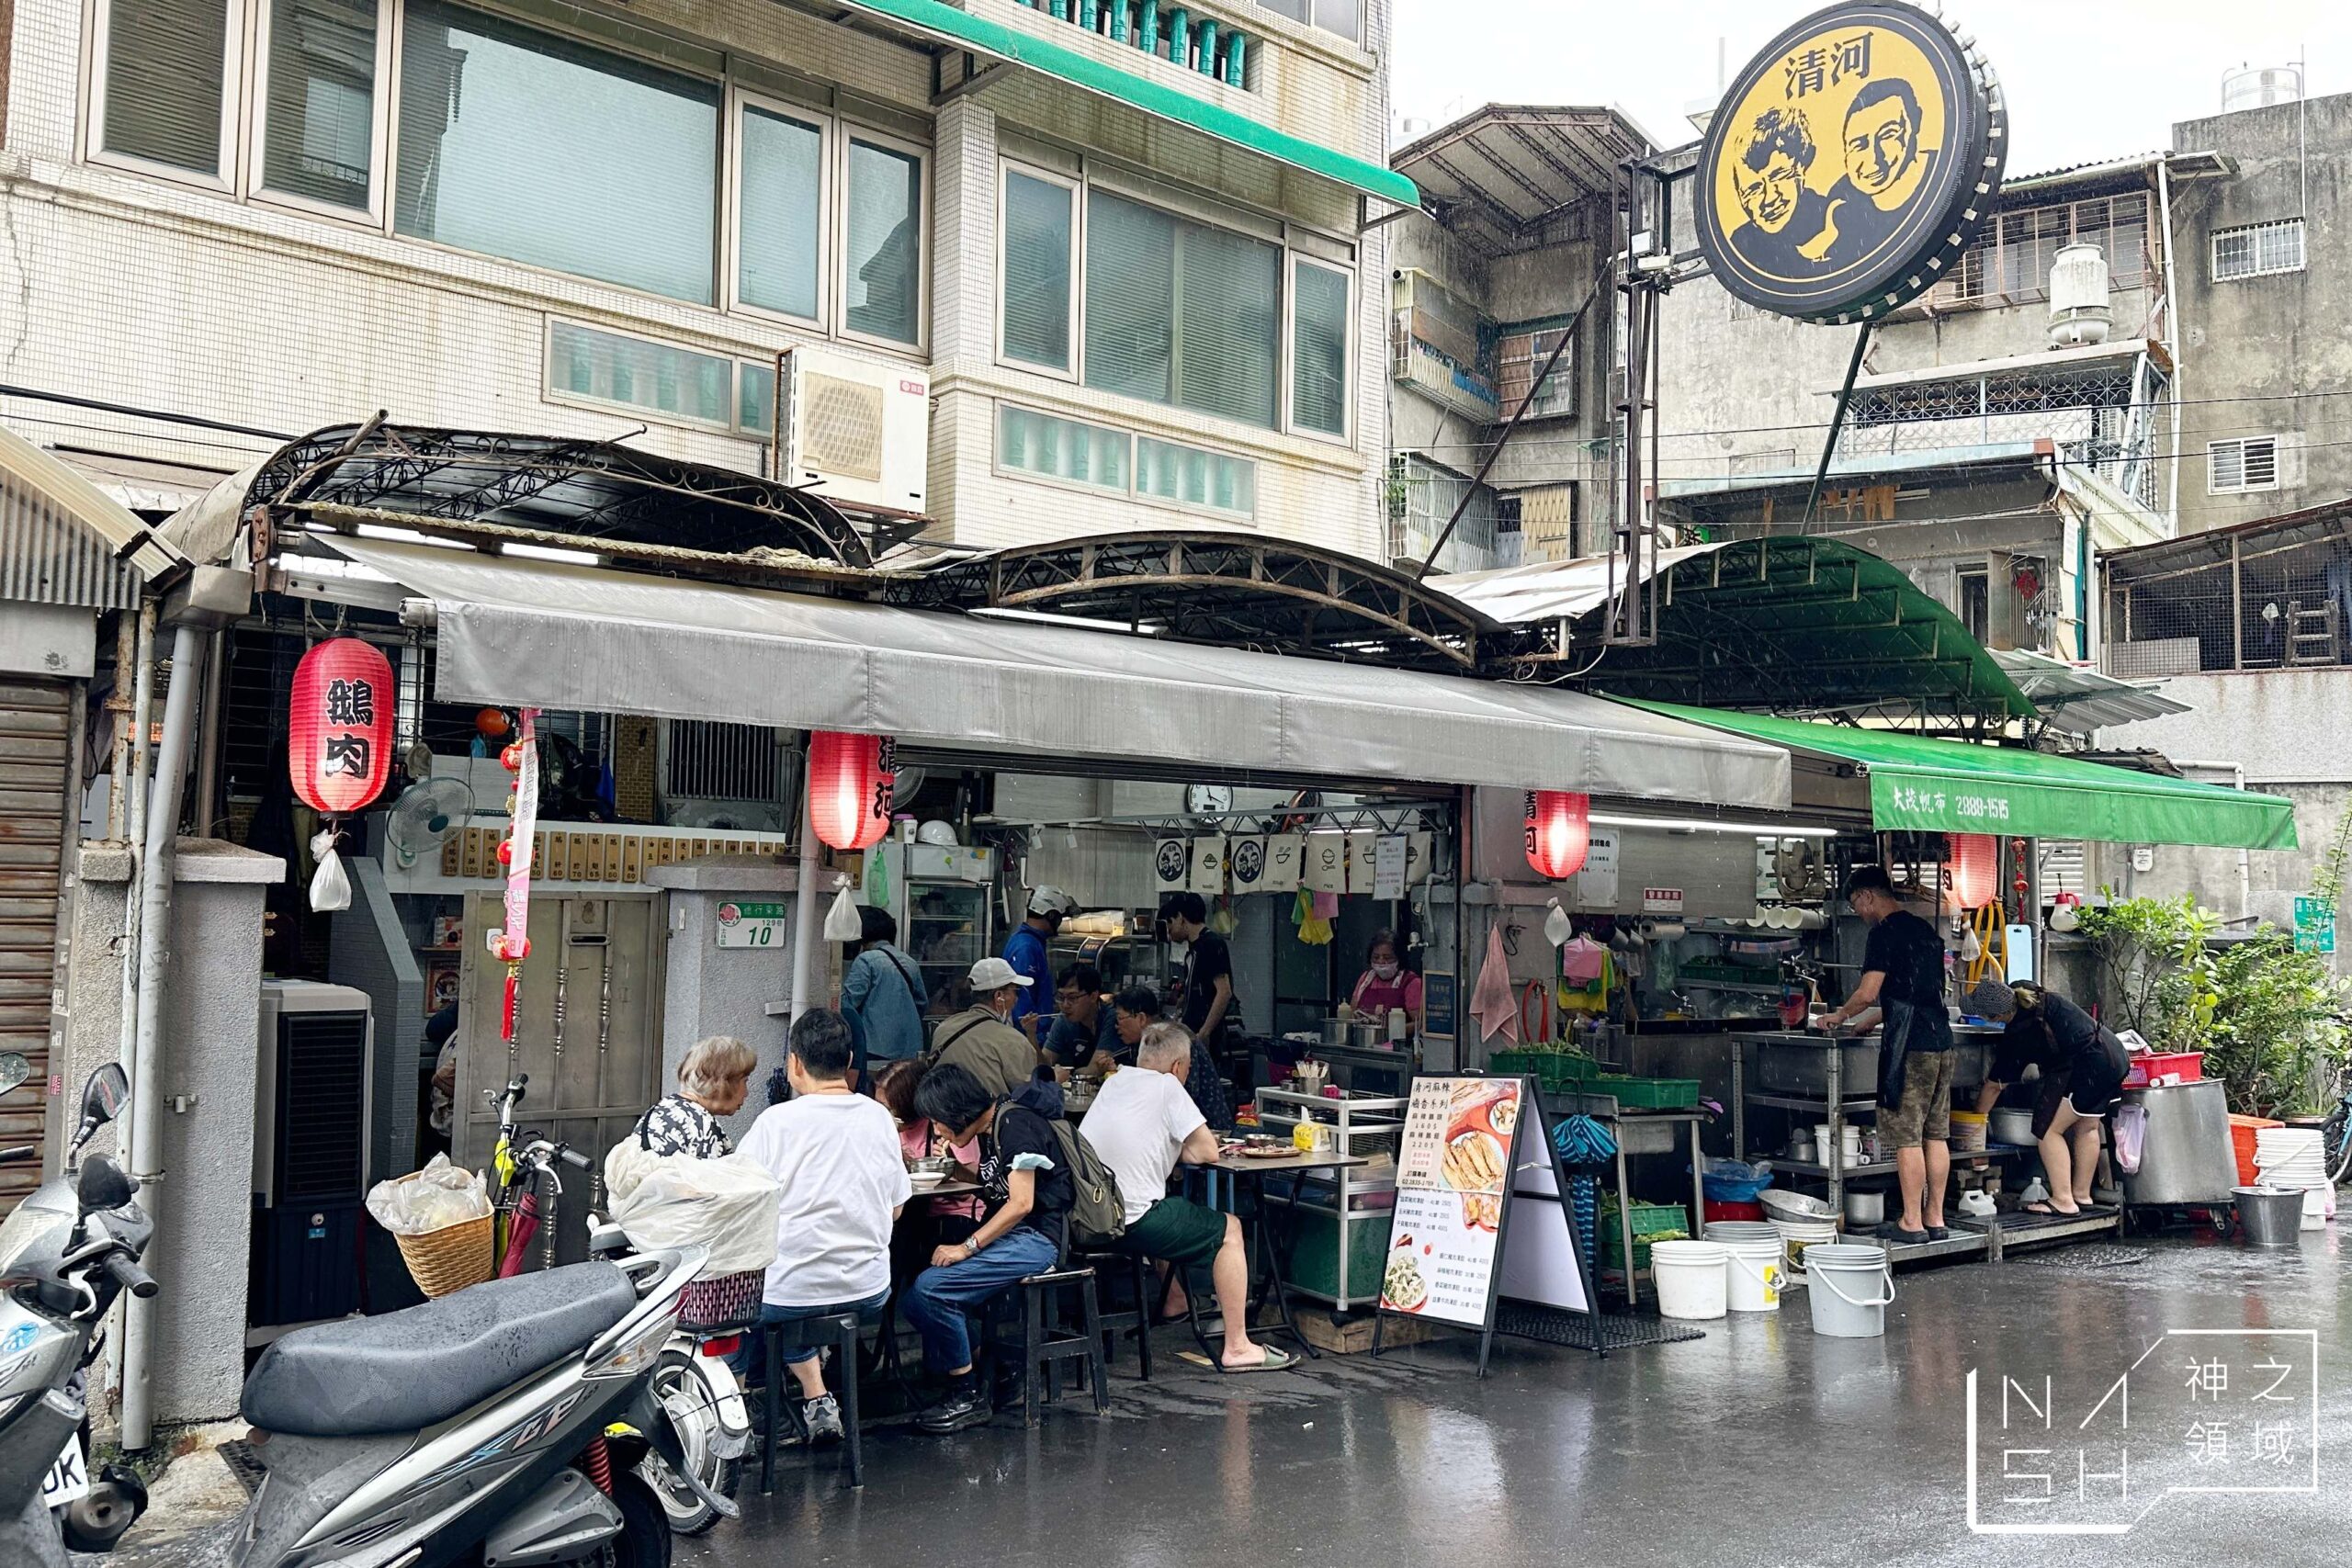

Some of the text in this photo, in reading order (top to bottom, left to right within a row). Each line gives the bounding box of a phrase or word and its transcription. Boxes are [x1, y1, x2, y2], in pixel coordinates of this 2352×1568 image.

[1784, 31, 1874, 100] 清河
[325, 679, 373, 780] 鵝肉
[1955, 795, 2009, 820] 2888-1515
[749, 926, 772, 945] 10
[1413, 1081, 1451, 1093] 清河麻辣
